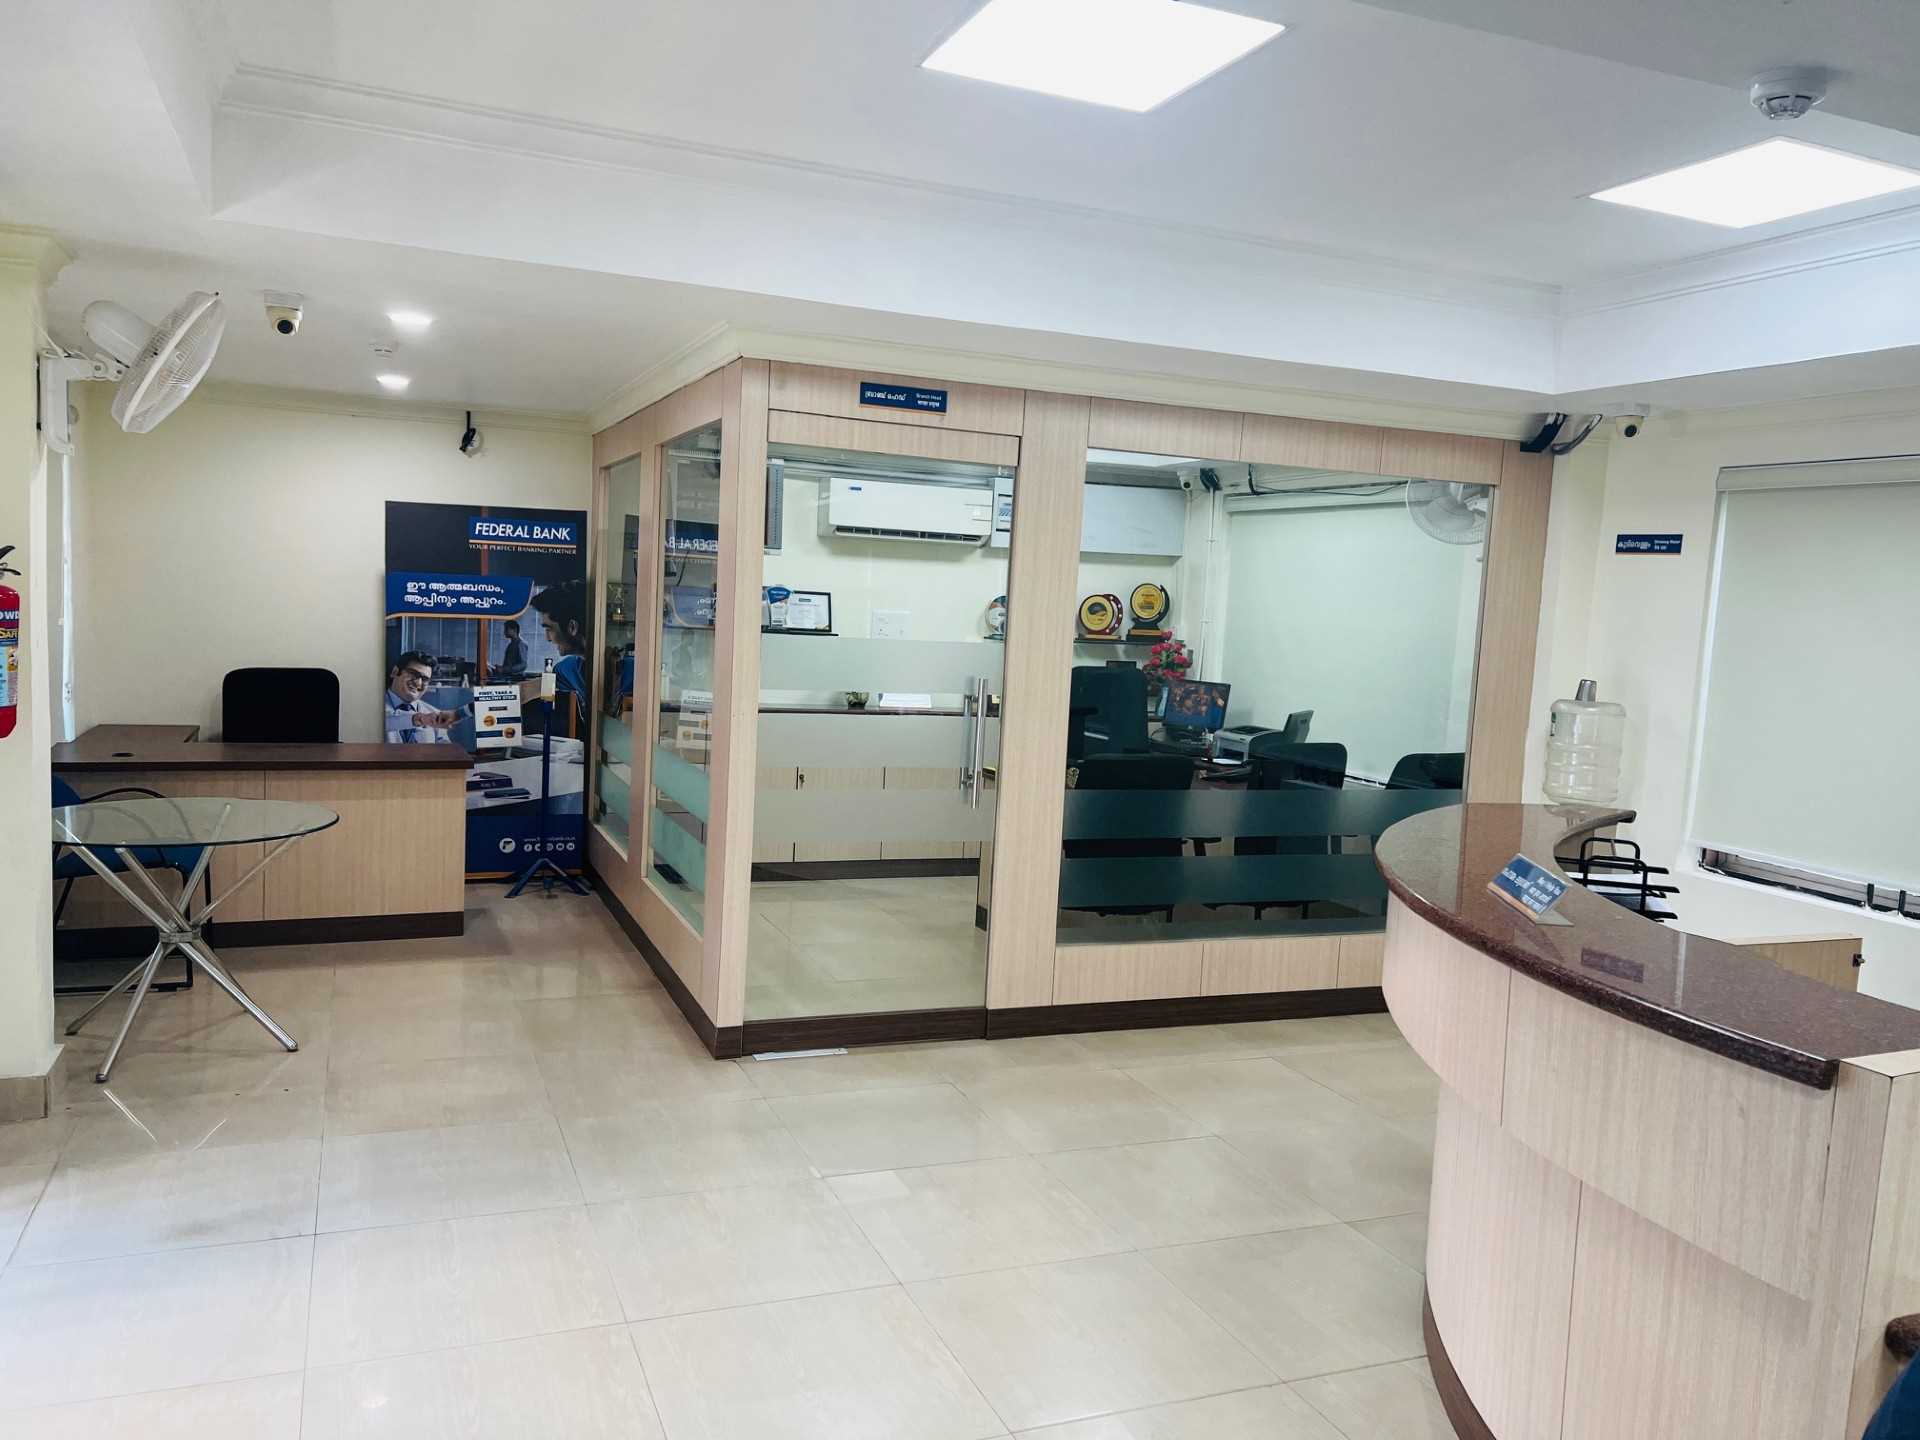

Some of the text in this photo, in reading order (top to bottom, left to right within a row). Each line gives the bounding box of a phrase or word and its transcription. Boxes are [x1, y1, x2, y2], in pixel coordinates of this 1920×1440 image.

[475, 522, 571, 541] FEDERAL BANK
[406, 581, 427, 593] ഈ
